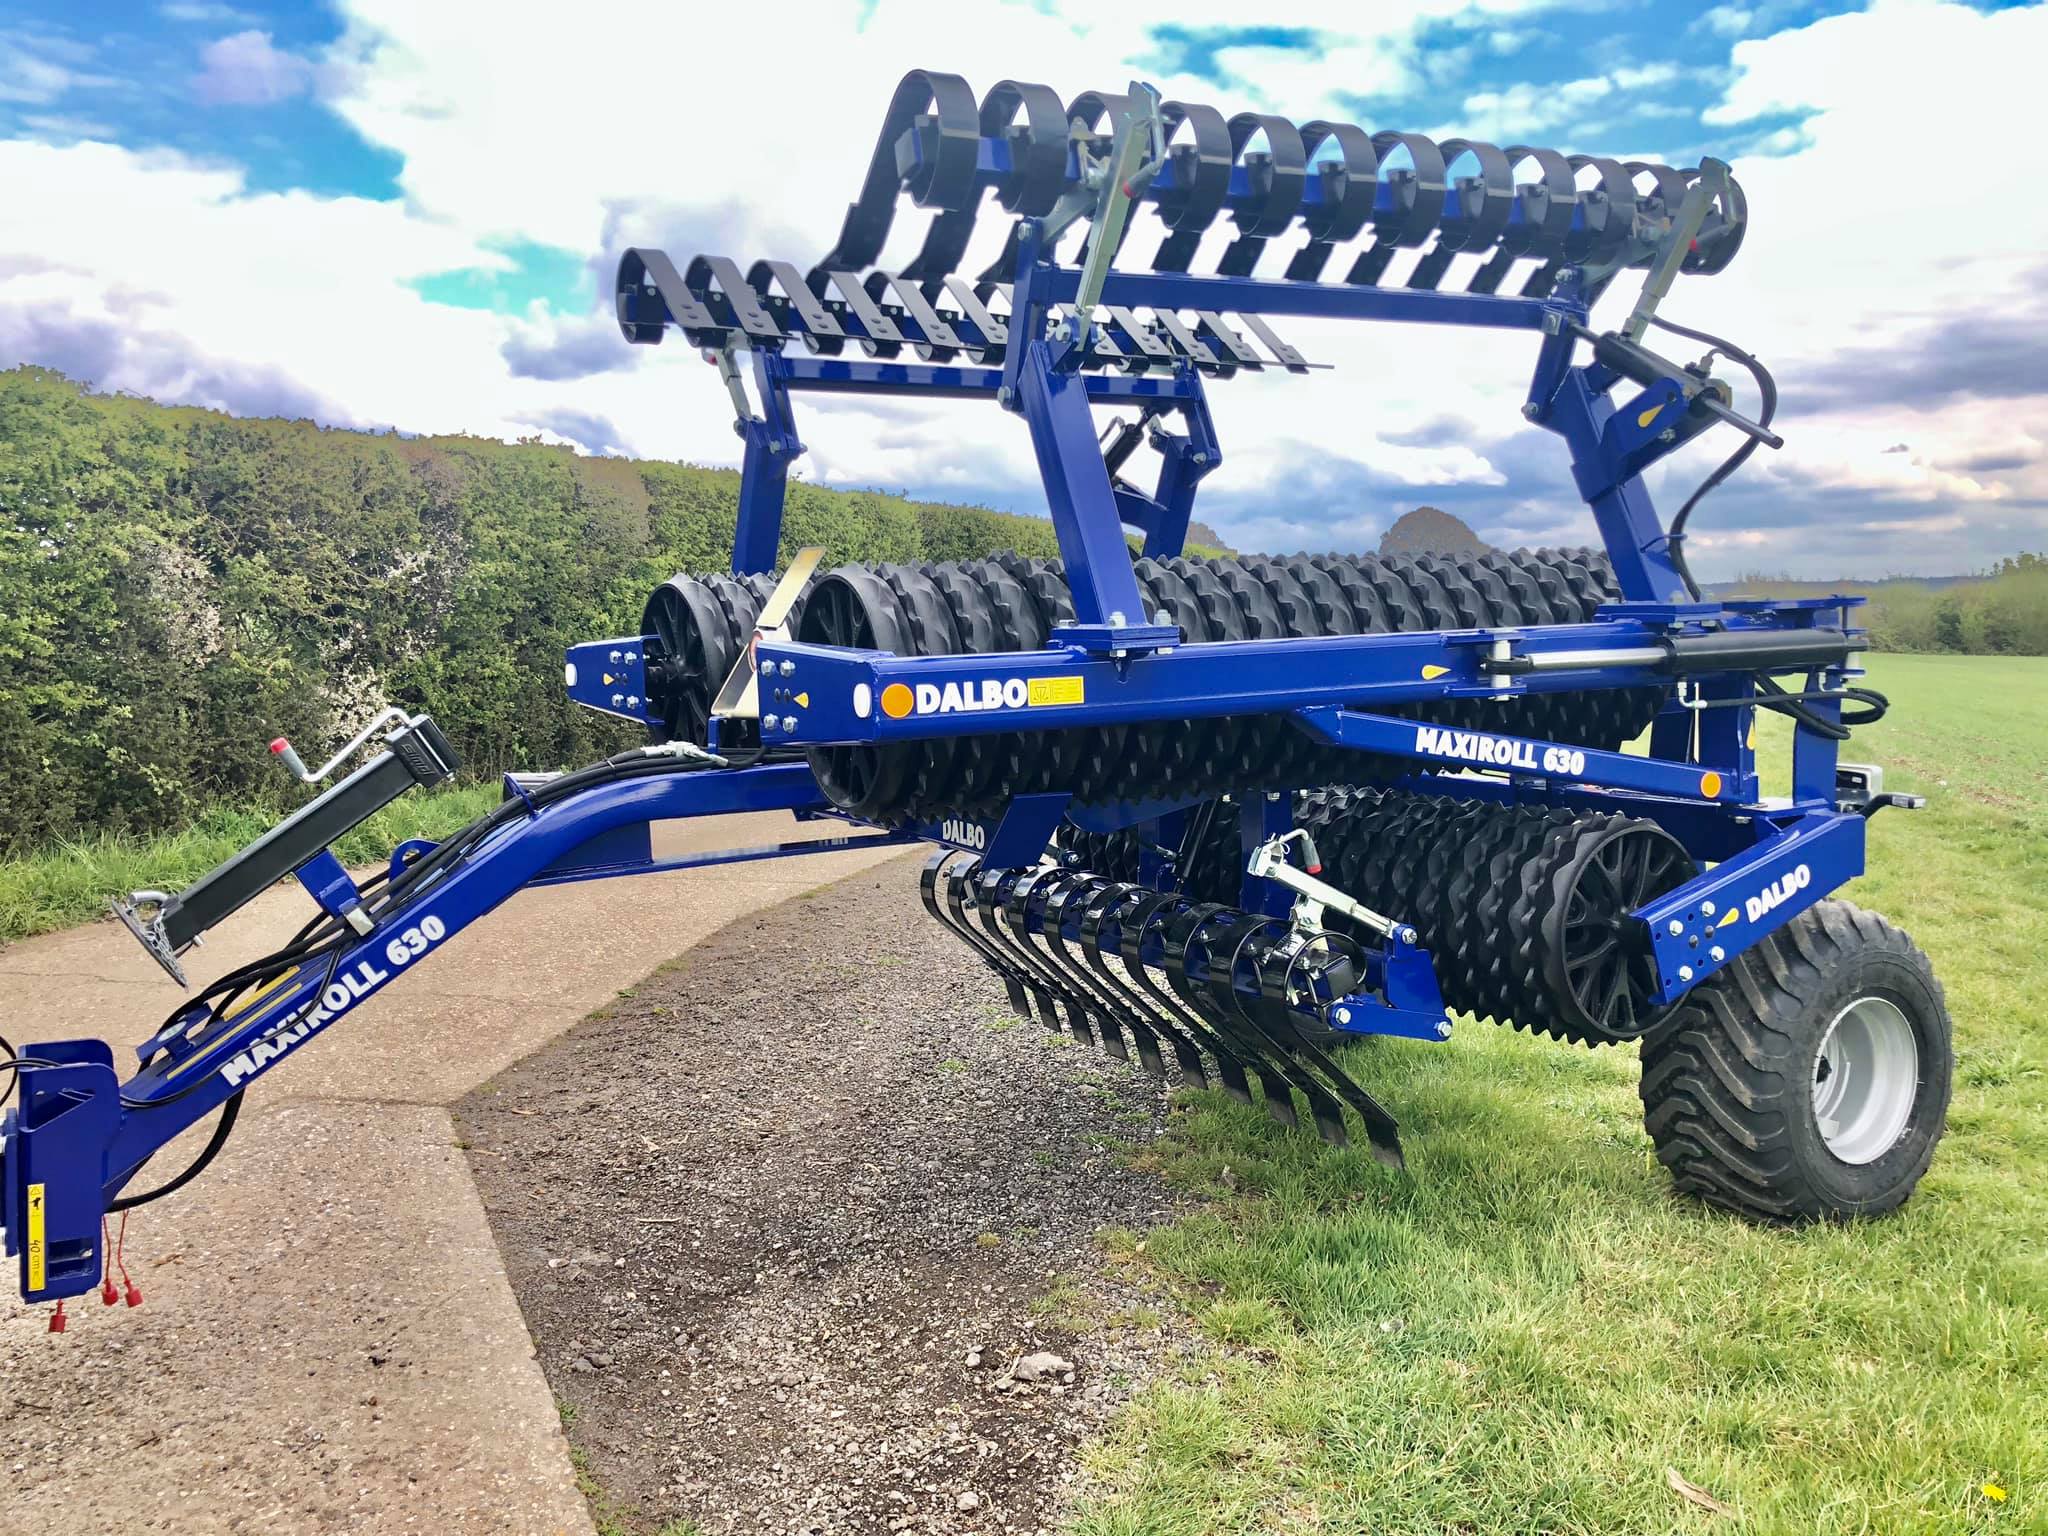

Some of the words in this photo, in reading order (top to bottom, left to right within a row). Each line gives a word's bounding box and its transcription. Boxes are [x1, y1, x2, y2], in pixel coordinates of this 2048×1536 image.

[916, 678, 1028, 714] DALBO
[1415, 726, 1538, 769] MAXIROLL
[1543, 747, 1585, 776] 630
[942, 818, 985, 850] DALBO
[1745, 864, 1810, 923] DALBO
[220, 961, 389, 1087] MAXIROLL
[386, 915, 446, 966] 630
